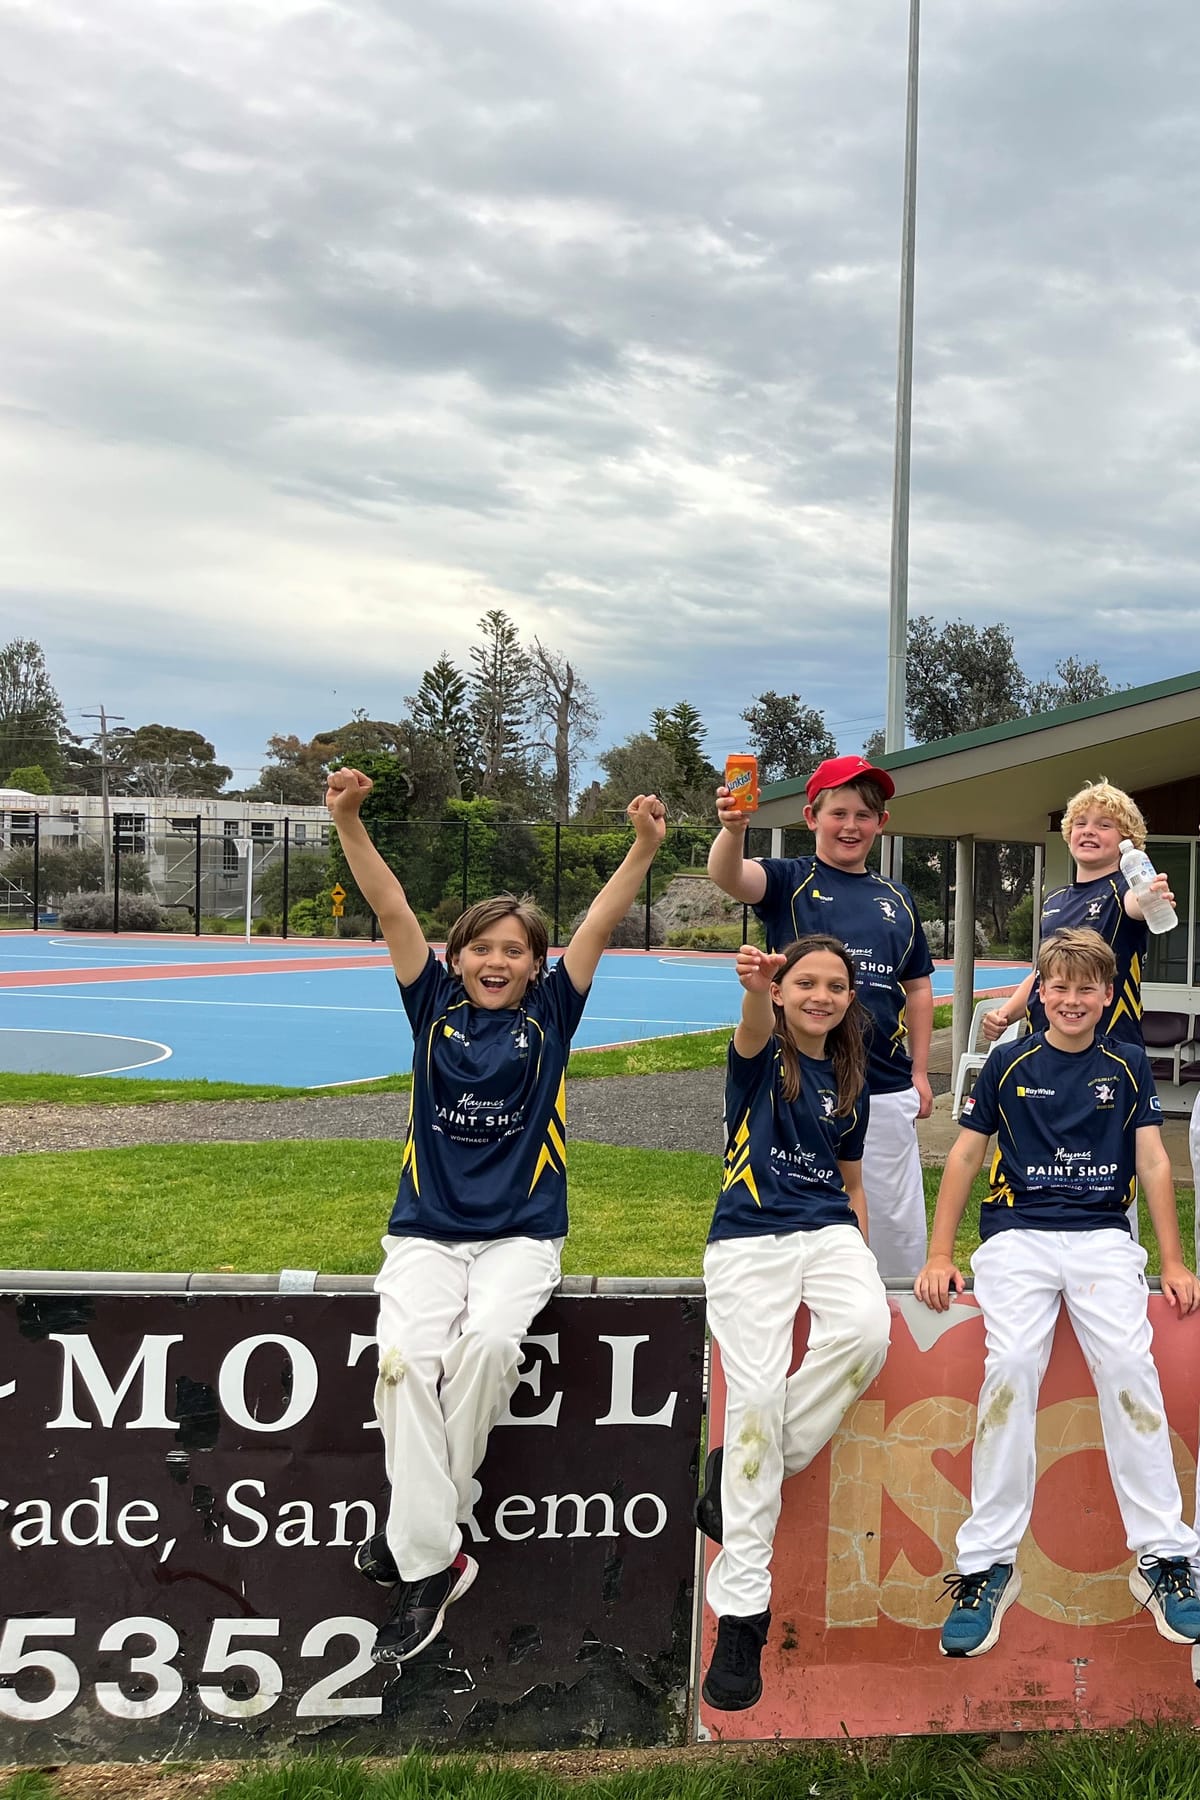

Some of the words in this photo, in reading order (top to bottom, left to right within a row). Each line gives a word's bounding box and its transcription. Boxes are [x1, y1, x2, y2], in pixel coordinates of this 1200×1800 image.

[859, 961, 894, 975] SHOP
[770, 1146, 802, 1165] PAIN
[1026, 1165, 1073, 1177] PAINT
[1078, 1163, 1118, 1177] SHOP
[46, 1333, 678, 1432] MOEL
[0, 1475, 177, 1563] ade,
[222, 1478, 378, 1548] San
[0, 1615, 383, 1721] 5352
